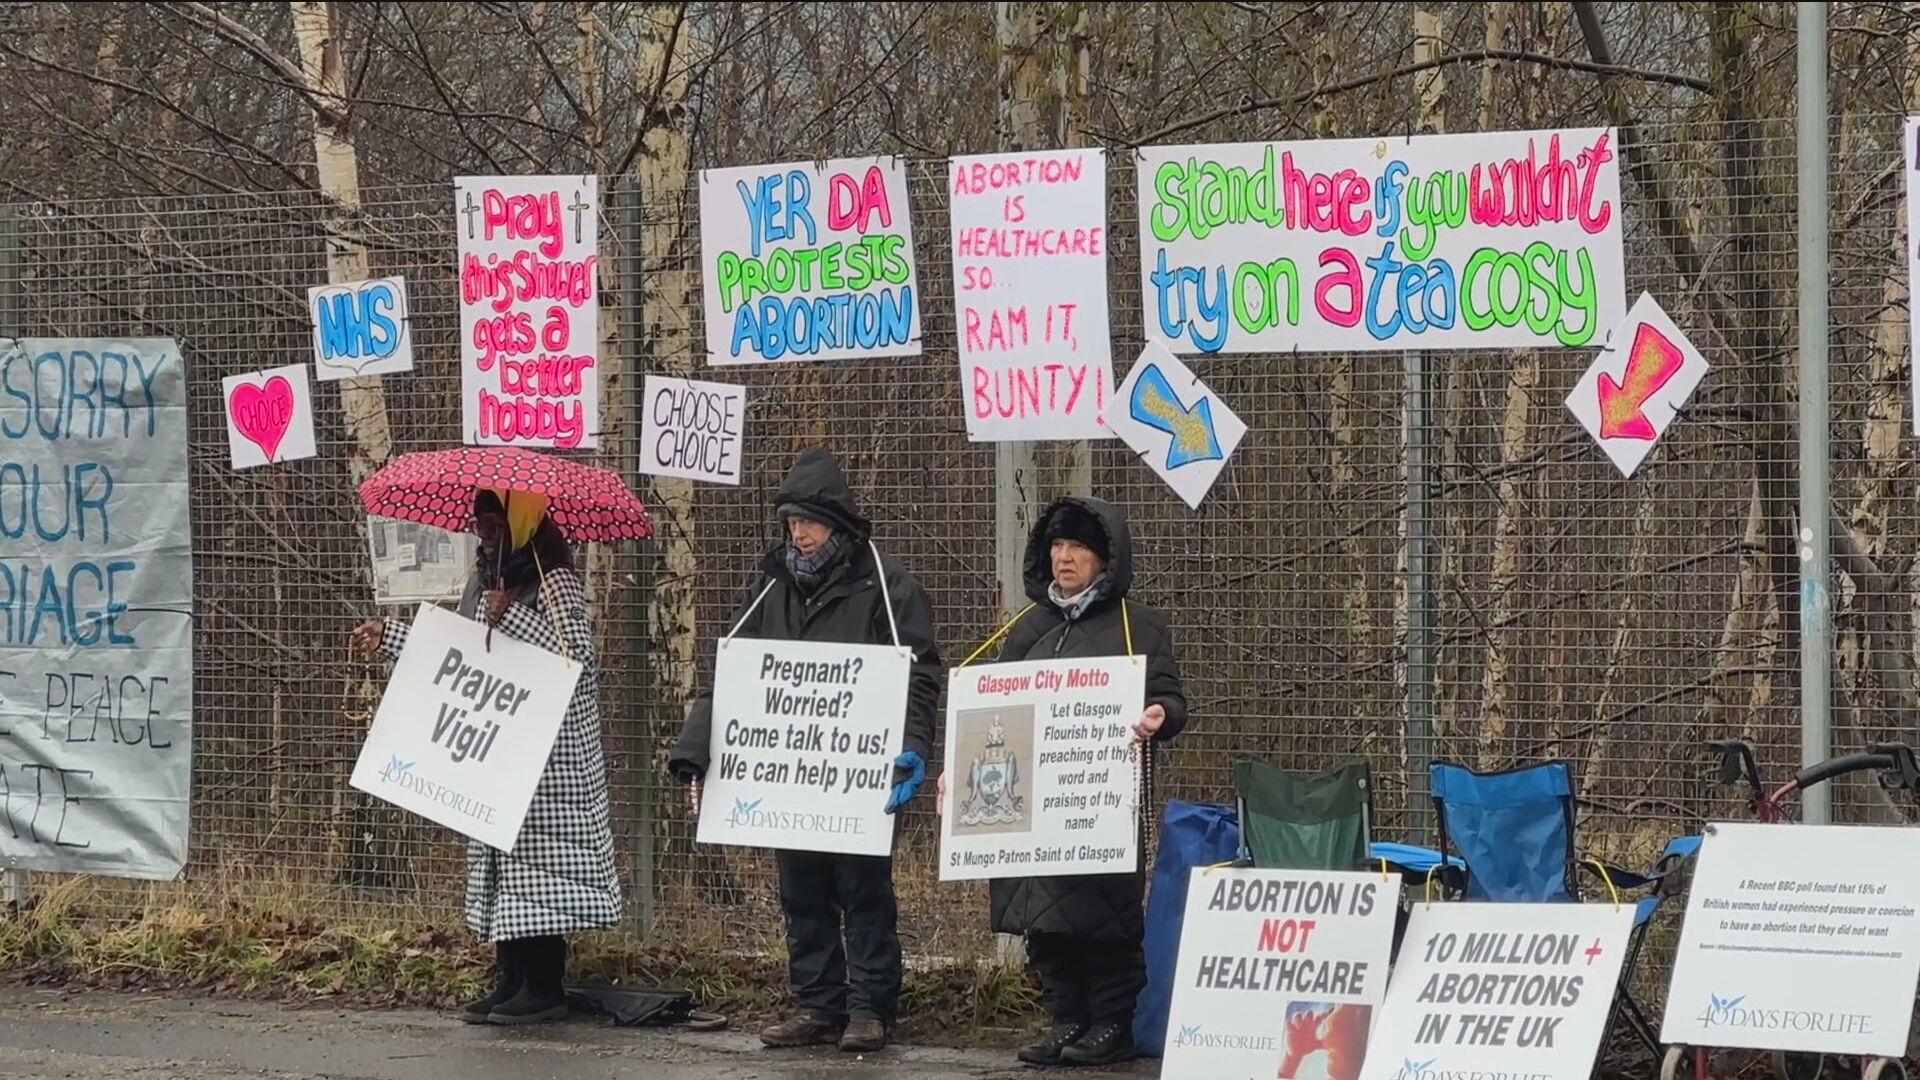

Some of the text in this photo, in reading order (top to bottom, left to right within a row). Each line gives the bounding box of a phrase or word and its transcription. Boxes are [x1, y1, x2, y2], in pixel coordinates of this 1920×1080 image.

[954, 154, 1083, 195] ABORTION
[736, 165, 892, 256] YER DA
[1004, 196, 1025, 223] IS
[1282, 151, 1371, 236] here
[1375, 160, 1409, 238] if
[1399, 169, 1467, 261] you
[1470, 133, 1613, 234] wouldn't
[483, 189, 563, 259] Pray
[958, 227, 1102, 257] HEALTHCARE
[462, 252, 514, 312] this
[716, 234, 910, 313] PROTESTS
[1150, 248, 1229, 352] try
[1232, 257, 1300, 334] on
[1314, 247, 1364, 327] a
[1365, 241, 1456, 340] tea
[318, 284, 398, 359] NHS
[474, 306, 569, 371] gets a
[730, 286, 912, 360] ABORTION
[965, 304, 1077, 352] RAM IT,
[500, 354, 594, 397] better
[2, 350, 166, 440] SORRY
[240, 395, 286, 431] CHOICE
[653, 387, 738, 436] CHOOSE
[479, 388, 583, 448] hobby
[656, 429, 735, 476] CHOICE
[432, 646, 532, 717] Prayer
[760, 653, 863, 687] Pregnant?
[977, 668, 1110, 696] Glasgow City Motto
[40, 673, 171, 748] PEACE
[764, 687, 853, 718] Worried?
[1073, 702, 1122, 718] Glasgow
[430, 701, 500, 763] Vigil
[725, 719, 889, 756] Come talk to us!
[1044, 723, 1126, 741] Flourish by the
[720, 753, 889, 794] We can help you!
[1039, 745, 1129, 767] preaching of thy
[1058, 769, 1109, 785] word and
[1043, 791, 1122, 812] praising of thy
[950, 846, 1126, 868] St Mungo Patron Saint of Glasgow
[1208, 879, 1377, 917] ABORTION IS
[1738, 880, 1746, 890] A
[1747, 880, 1776, 891] Recent
[1777, 881, 1795, 891] BBC
[1795, 882, 1813, 894] poll
[1812, 883, 1837, 893] found
[1838, 884, 1856, 894] that
[1877, 884, 1887, 895] of
[1702, 898, 1915, 917] British women had experienced pressure or coercion
[1257, 918, 1315, 954] NOT
[1719, 920, 1889, 937] to have an abortion that they did not want
[1425, 933, 1457, 963] 10
[1459, 932, 1580, 967] MILLION
[1196, 956, 1369, 995] HEALTHCARE
[1416, 973, 1584, 1007] ABORTIONS
[1414, 1013, 1564, 1048] IN THE UK
